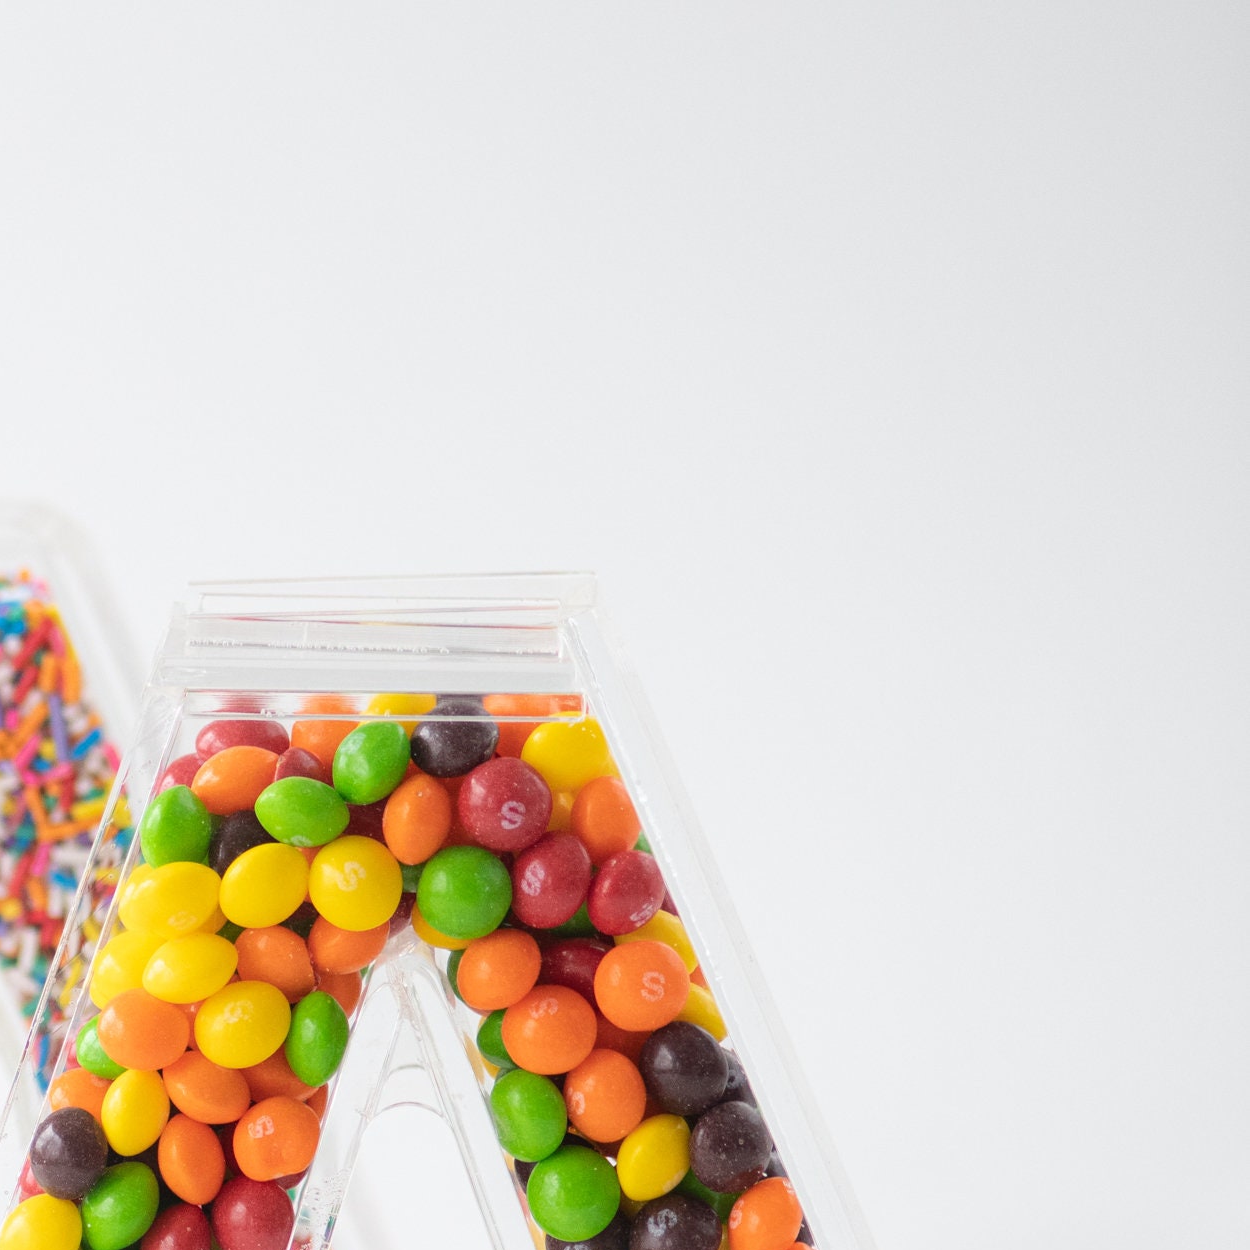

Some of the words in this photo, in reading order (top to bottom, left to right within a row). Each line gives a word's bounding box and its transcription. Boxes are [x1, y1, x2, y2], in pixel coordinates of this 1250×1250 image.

[501, 801, 526, 829] S
[337, 861, 366, 891] S
[521, 860, 545, 896] S
[640, 971, 665, 1002] S
[528, 997, 559, 1020] S
[248, 1115, 275, 1139] S
[647, 1208, 678, 1237] S
